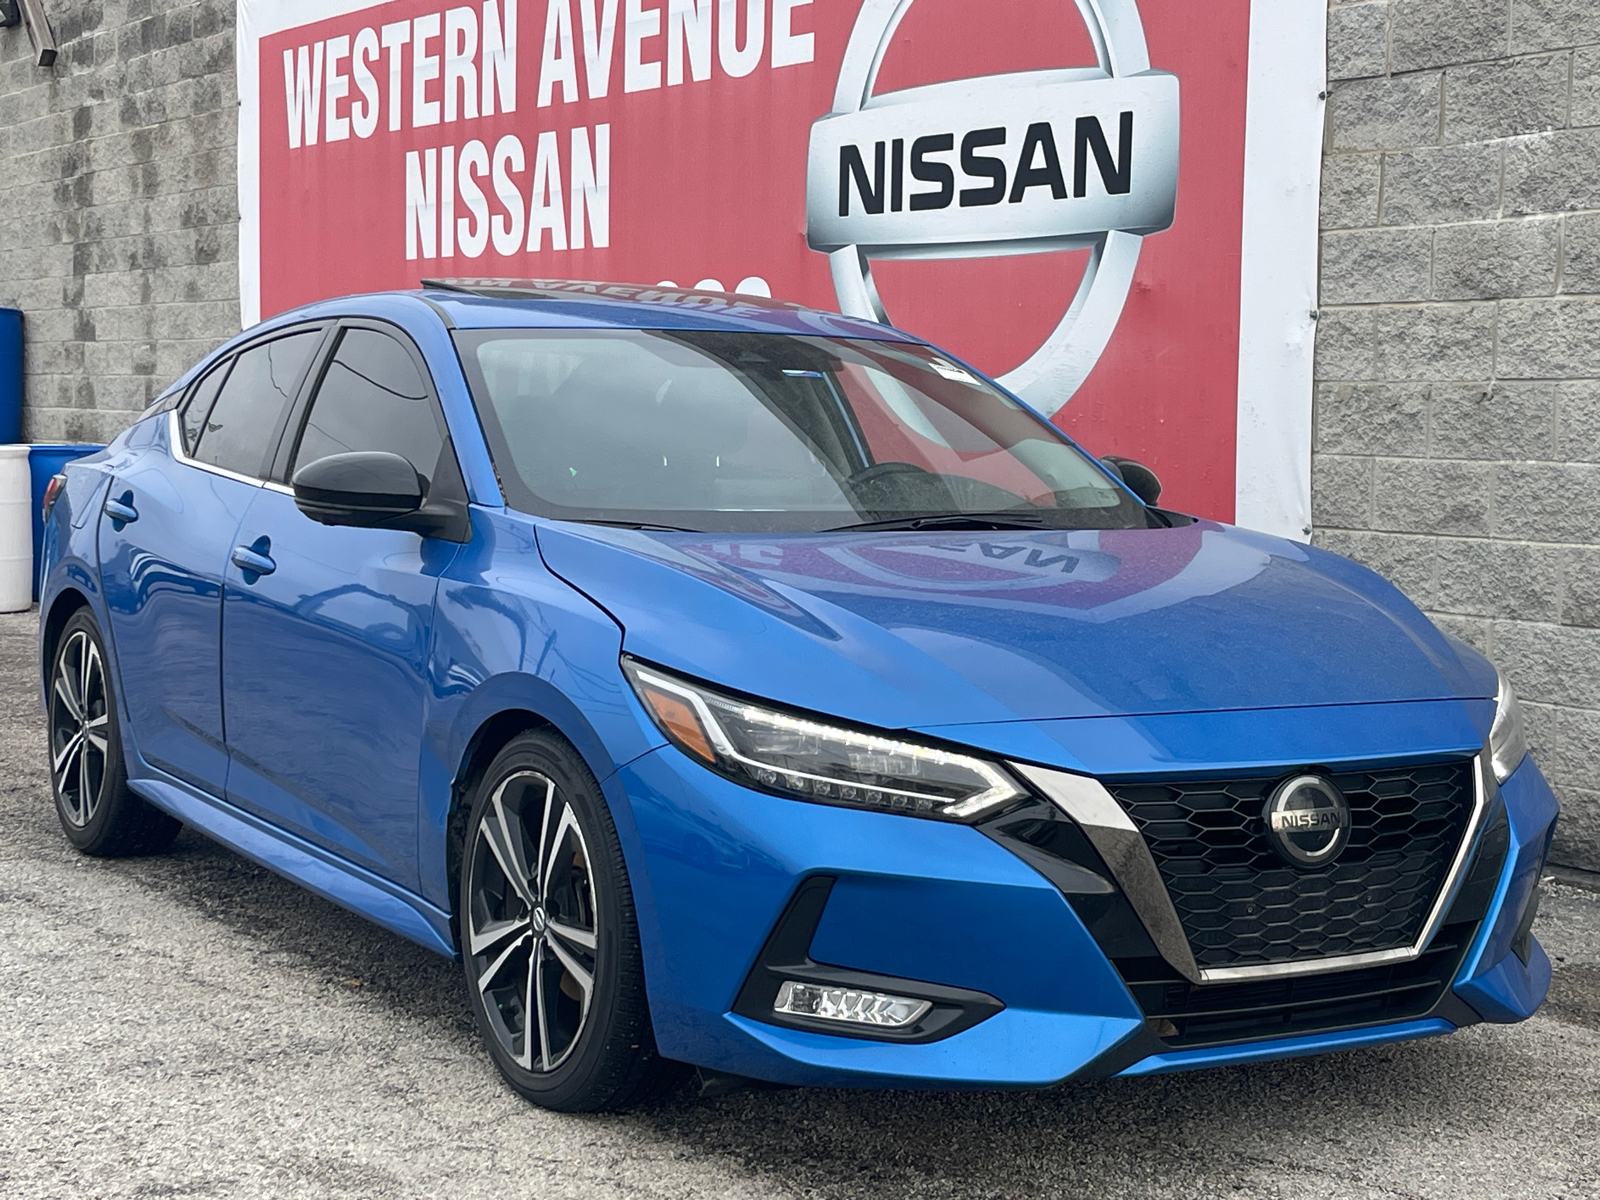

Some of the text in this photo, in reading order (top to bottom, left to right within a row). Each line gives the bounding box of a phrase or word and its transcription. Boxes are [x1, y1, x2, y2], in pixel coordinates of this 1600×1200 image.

[283, 0, 517, 149] WESTERN
[405, 123, 610, 260] NISSAN
[838, 111, 1133, 217] NISSAN
[1281, 811, 1341, 828] NISSAN
